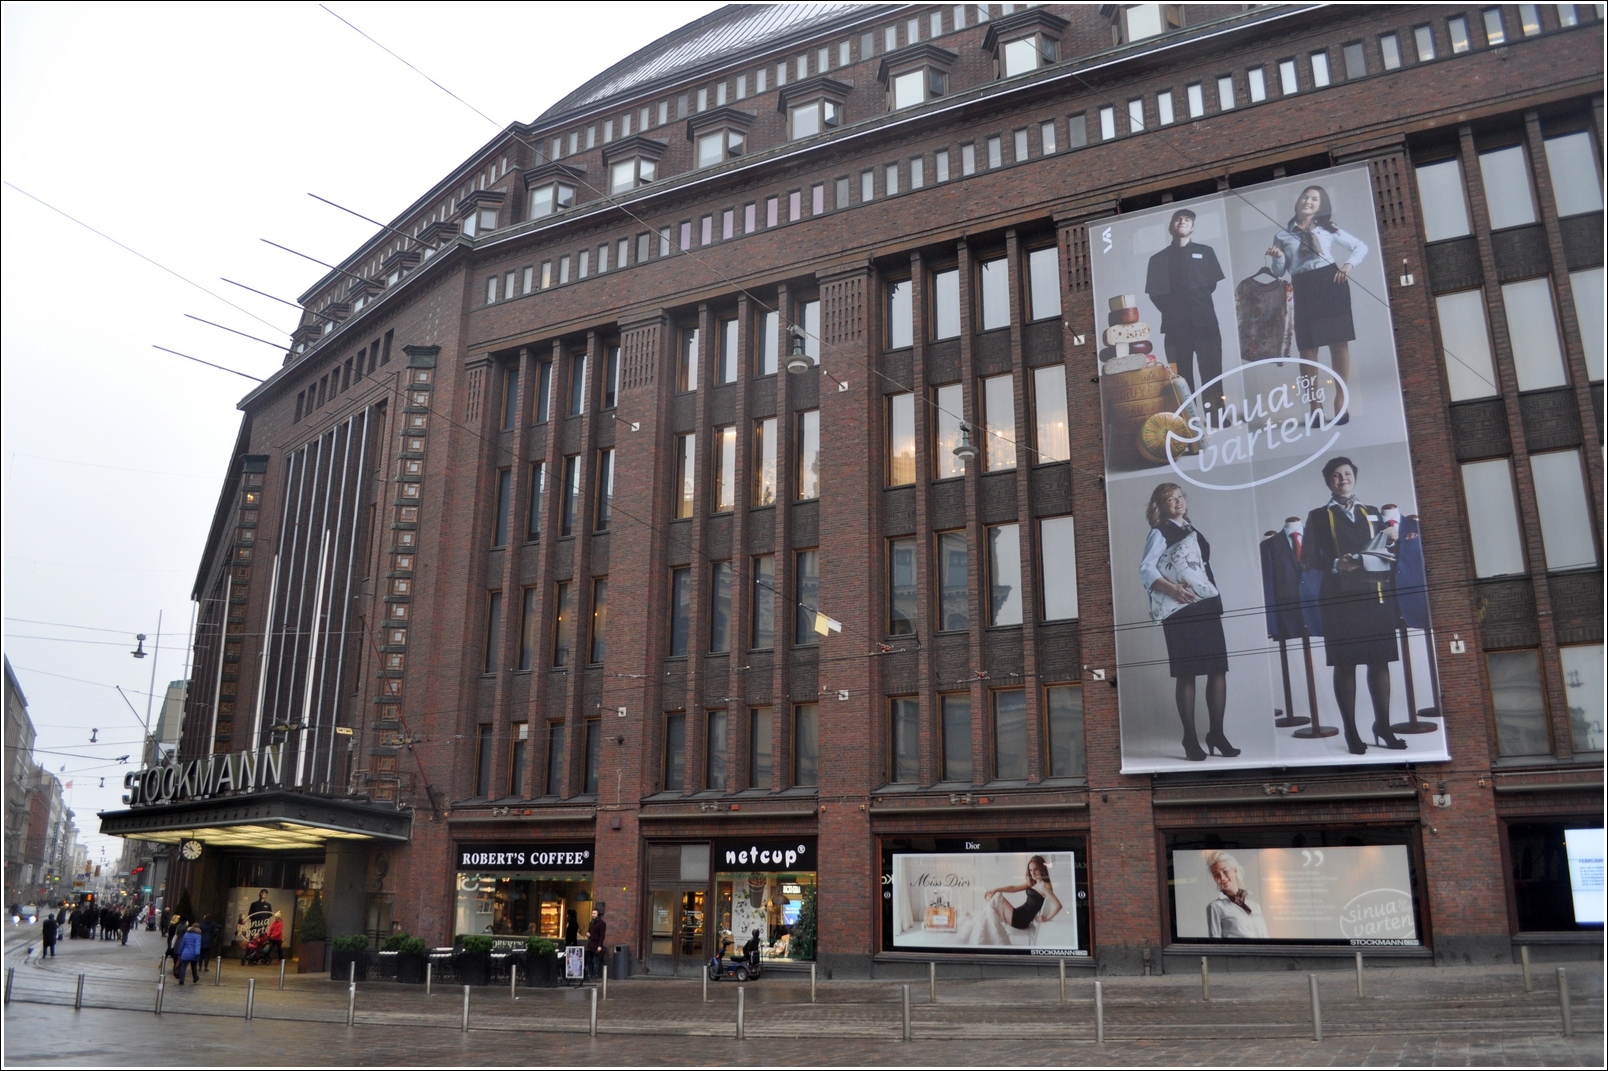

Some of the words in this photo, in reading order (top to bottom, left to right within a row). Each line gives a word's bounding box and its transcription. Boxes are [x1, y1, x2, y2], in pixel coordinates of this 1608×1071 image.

[1295, 374, 1317, 396] för
[1187, 383, 1294, 440] sinua
[1301, 386, 1326, 404] dig
[1199, 408, 1329, 473] varten
[121, 742, 286, 805] STOCKMANN
[965, 841, 981, 850] Dior
[462, 852, 525, 865] ROBERT'S
[909, 873, 942, 887] Miss
[943, 873, 971, 887] Dior
[1349, 901, 1398, 922] sinua
[246, 926, 270, 937] varte
[1354, 914, 1414, 937] varten
